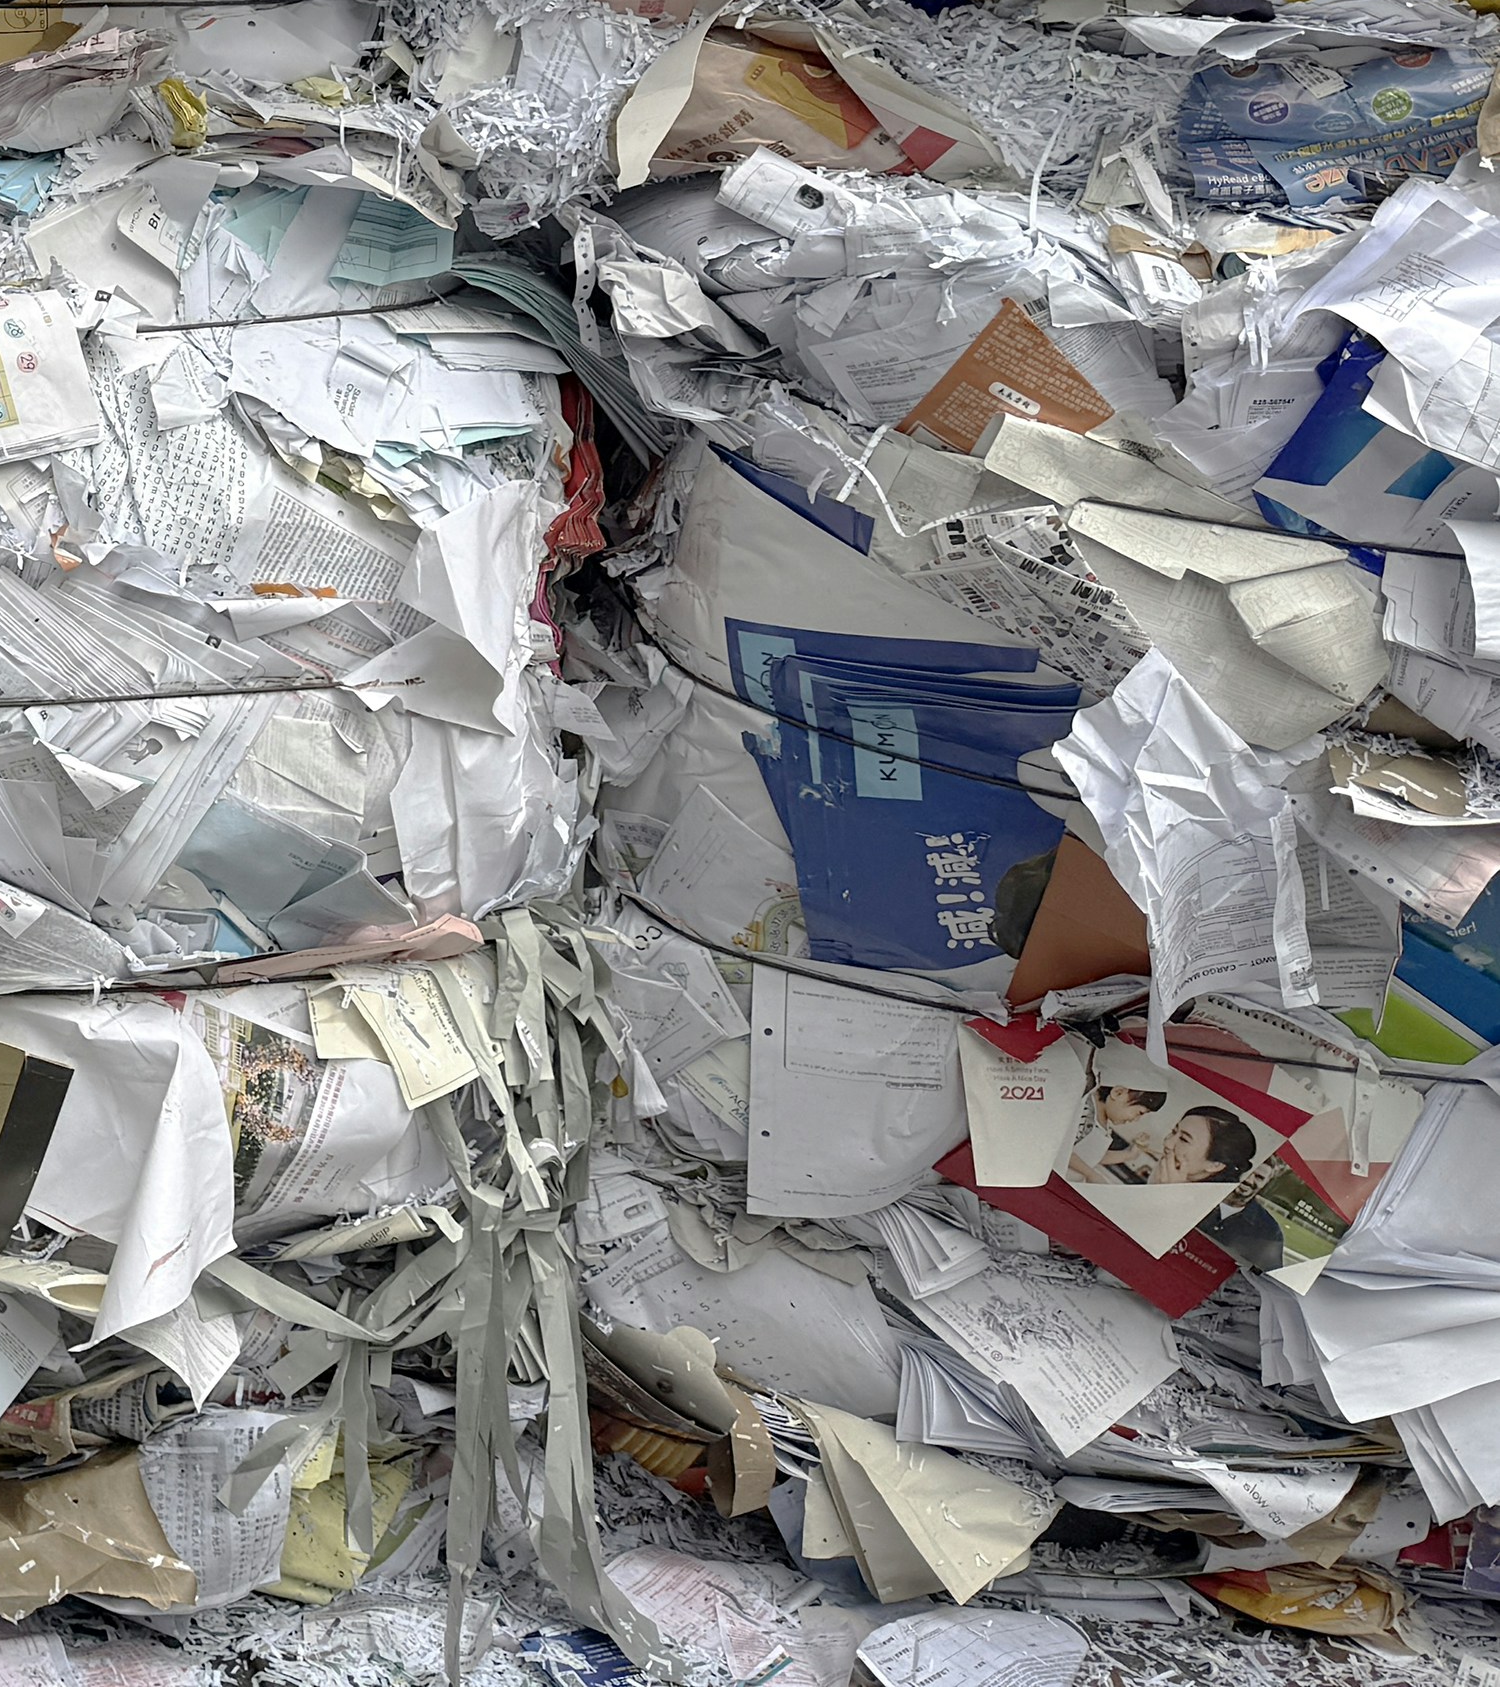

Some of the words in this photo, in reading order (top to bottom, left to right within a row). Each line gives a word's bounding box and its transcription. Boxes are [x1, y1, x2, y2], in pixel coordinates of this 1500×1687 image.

[1207, 175, 1250, 188] HyRead
[878, 712, 898, 783] KUMON
[1201, 963, 1237, 978] CARGO
[999, 1085, 1044, 1100] 2021
[1243, 1482, 1269, 1509] slow
[1268, 1510, 1286, 1527] car
